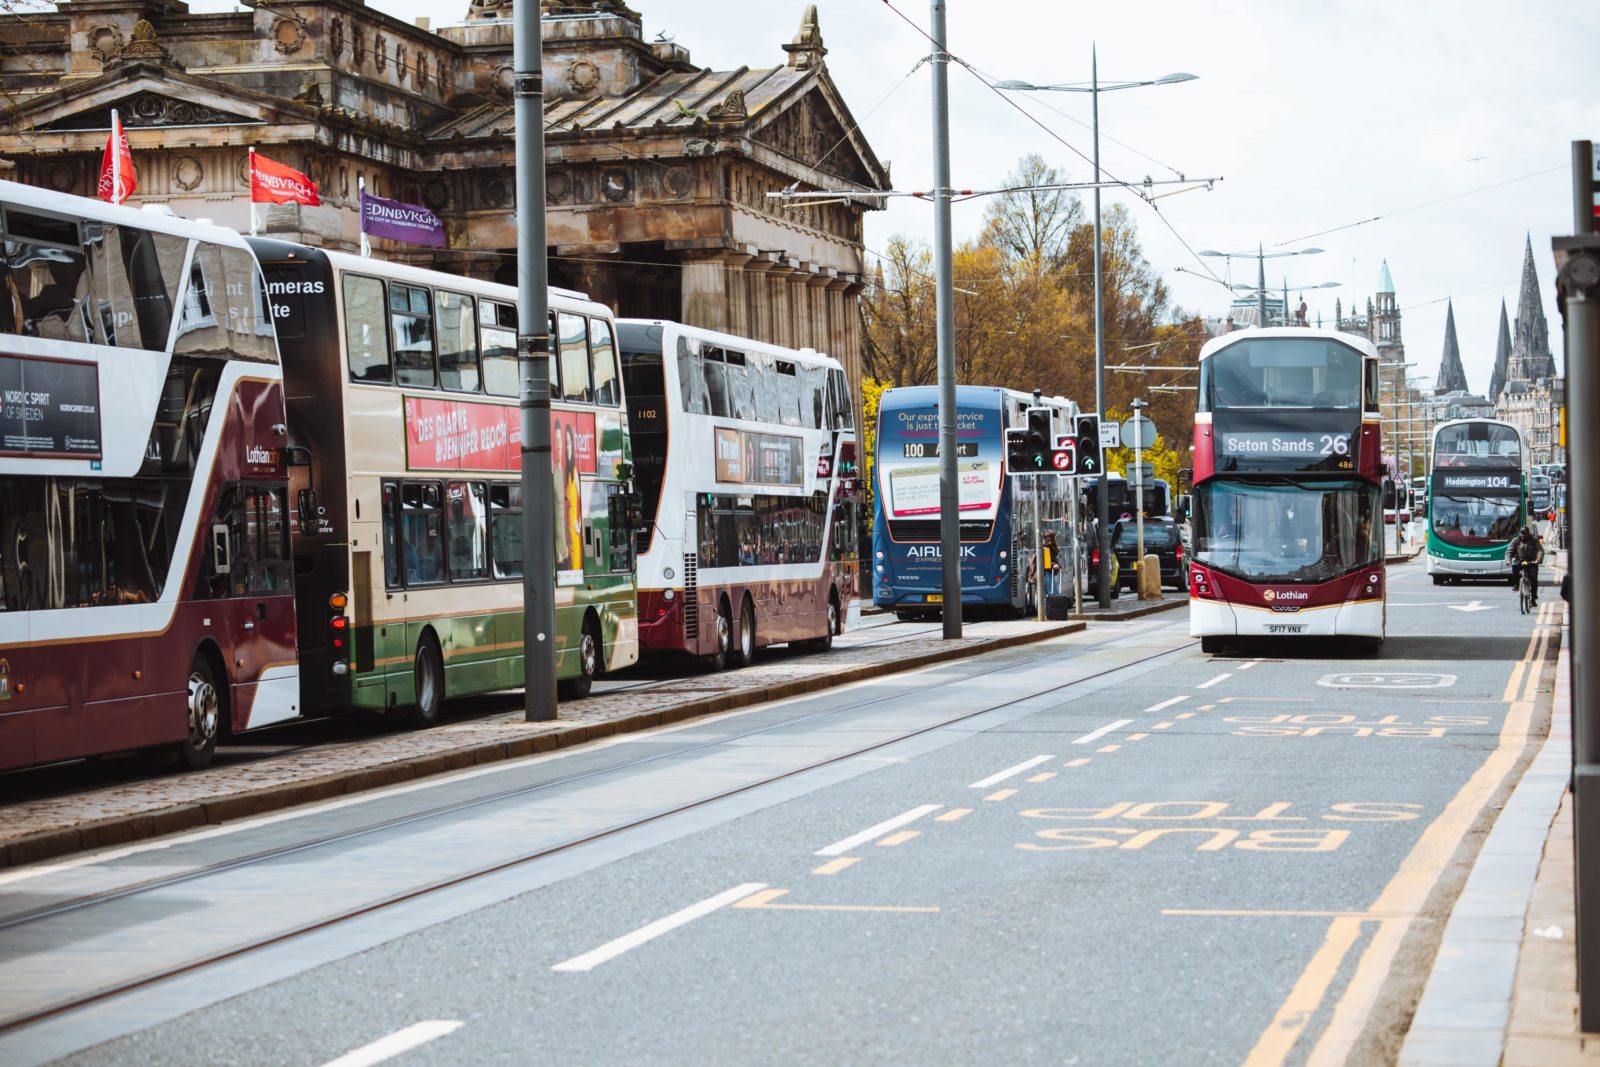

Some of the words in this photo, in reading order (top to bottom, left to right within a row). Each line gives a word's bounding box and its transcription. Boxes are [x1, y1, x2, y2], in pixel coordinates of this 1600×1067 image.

[30, 392, 50, 405] SPIRIT
[638, 410, 657, 419] 1102
[898, 412, 915, 421] Our
[957, 412, 984, 421] ervice
[417, 416, 433, 442] DES
[906, 421, 914, 430] is
[915, 421, 932, 431] just
[957, 421, 976, 430] cket
[480, 422, 507, 451] REOCH
[904, 443, 924, 457] 100
[1228, 438, 1268, 452] Seton
[1271, 438, 1314, 452] Sands
[1319, 435, 1348, 455] 26
[1445, 476, 1486, 487] Haddington
[1487, 476, 1508, 488] 104
[907, 546, 976, 557] AIRLK
[1276, 590, 1308, 600] Lothian
[1269, 625, 1286, 633] SF17
[1287, 625, 1302, 633] VNX
[1017, 801, 1425, 822] STOP
[1014, 827, 1352, 852] BUS
